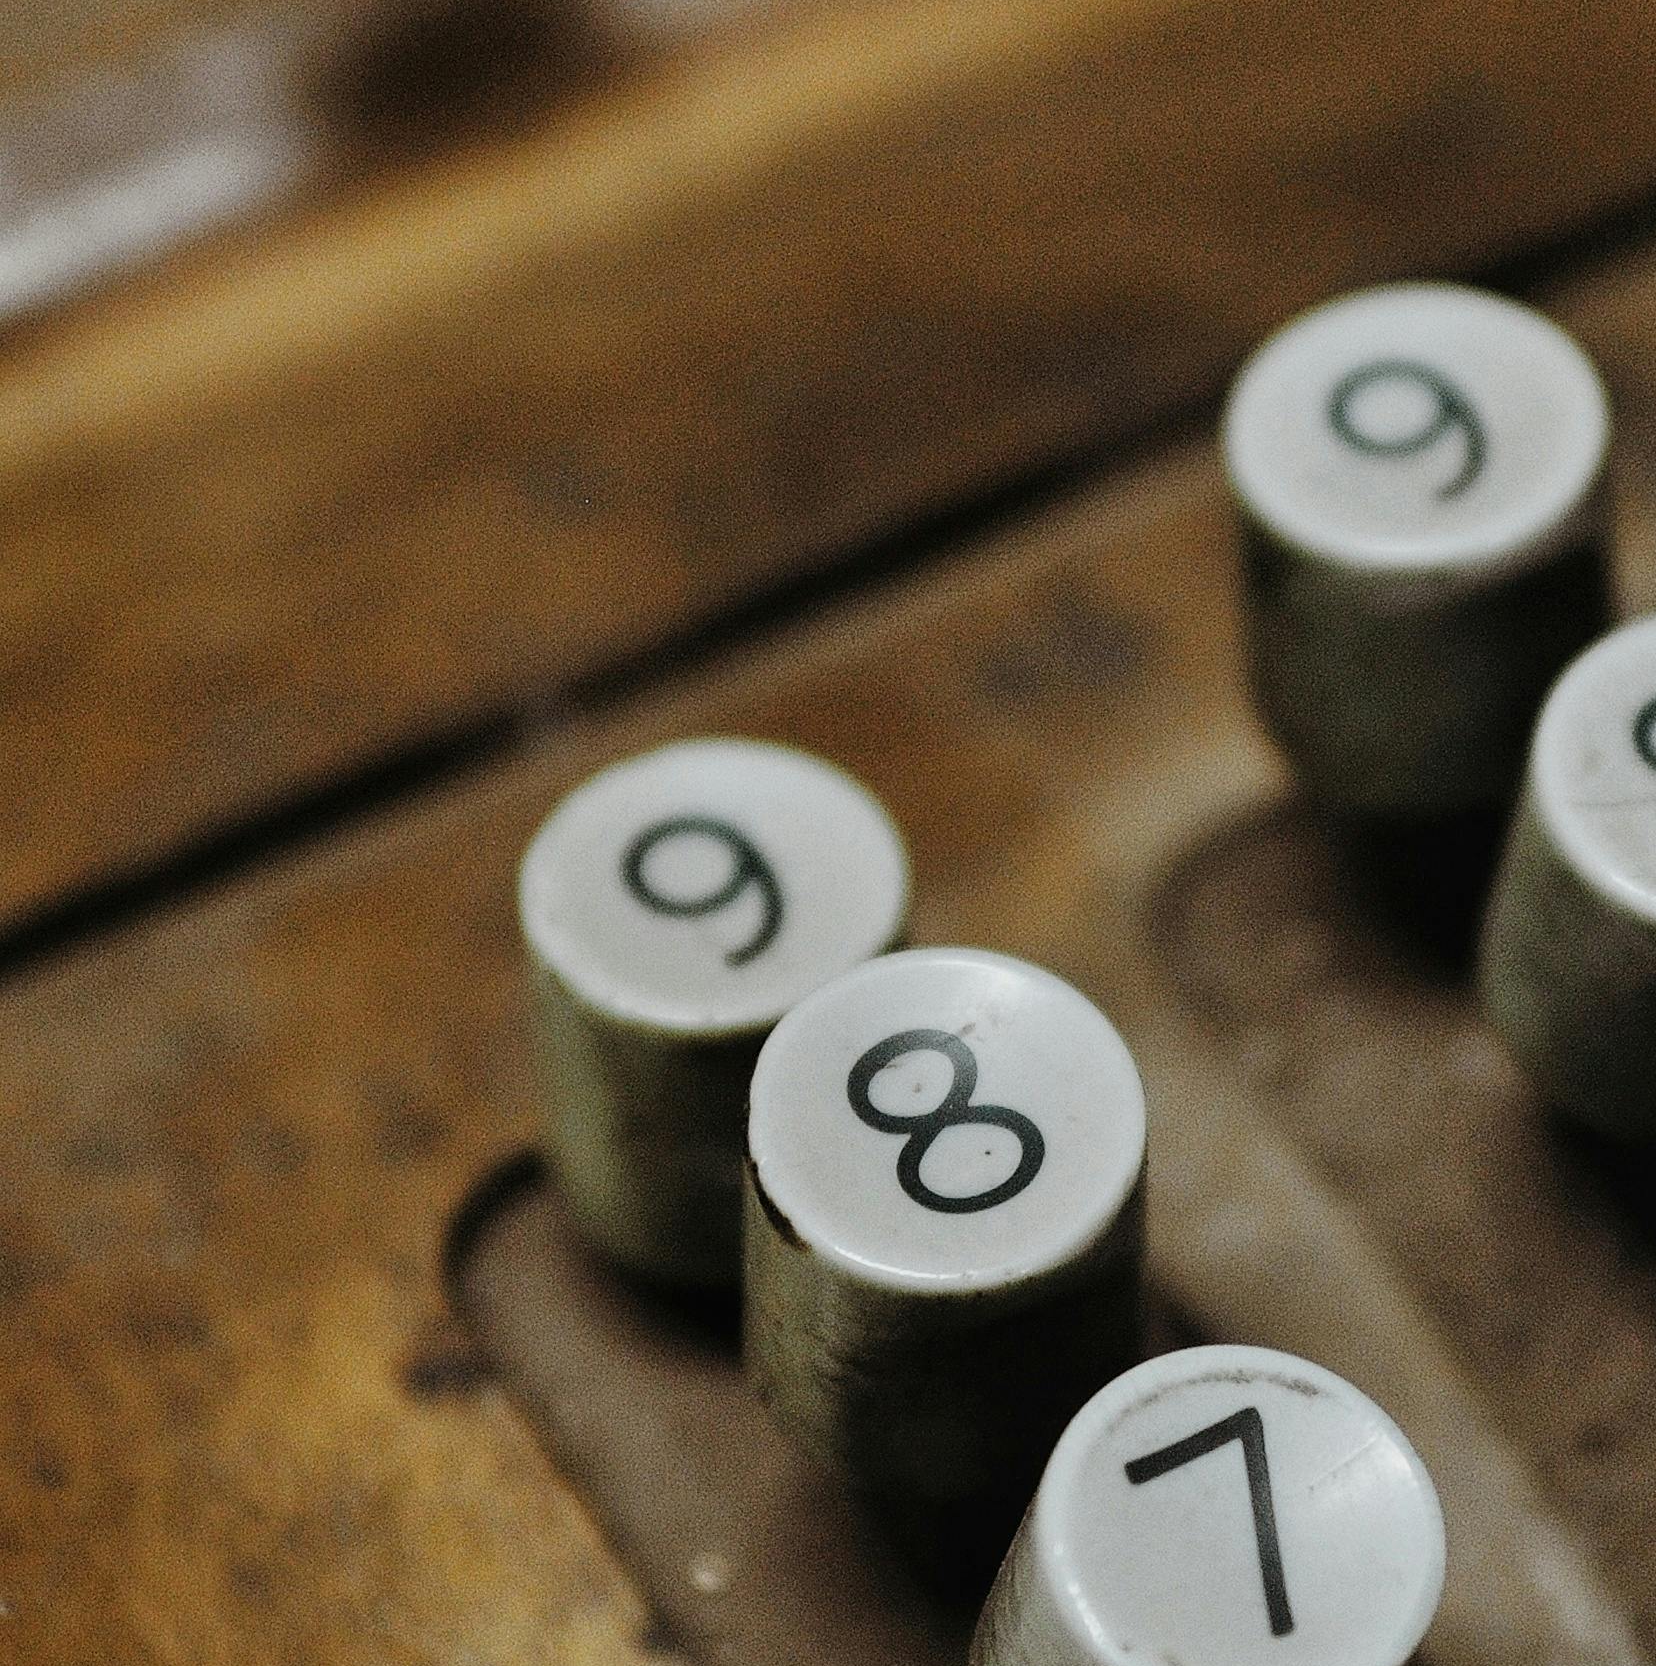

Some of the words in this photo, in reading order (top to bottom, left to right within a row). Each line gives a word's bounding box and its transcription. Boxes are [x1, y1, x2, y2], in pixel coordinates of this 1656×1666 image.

[1325, 363, 1490, 503] 9
[620, 818, 786, 968] 9
[846, 1034, 1046, 1215] 8
[1124, 1408, 1294, 1637] 7
